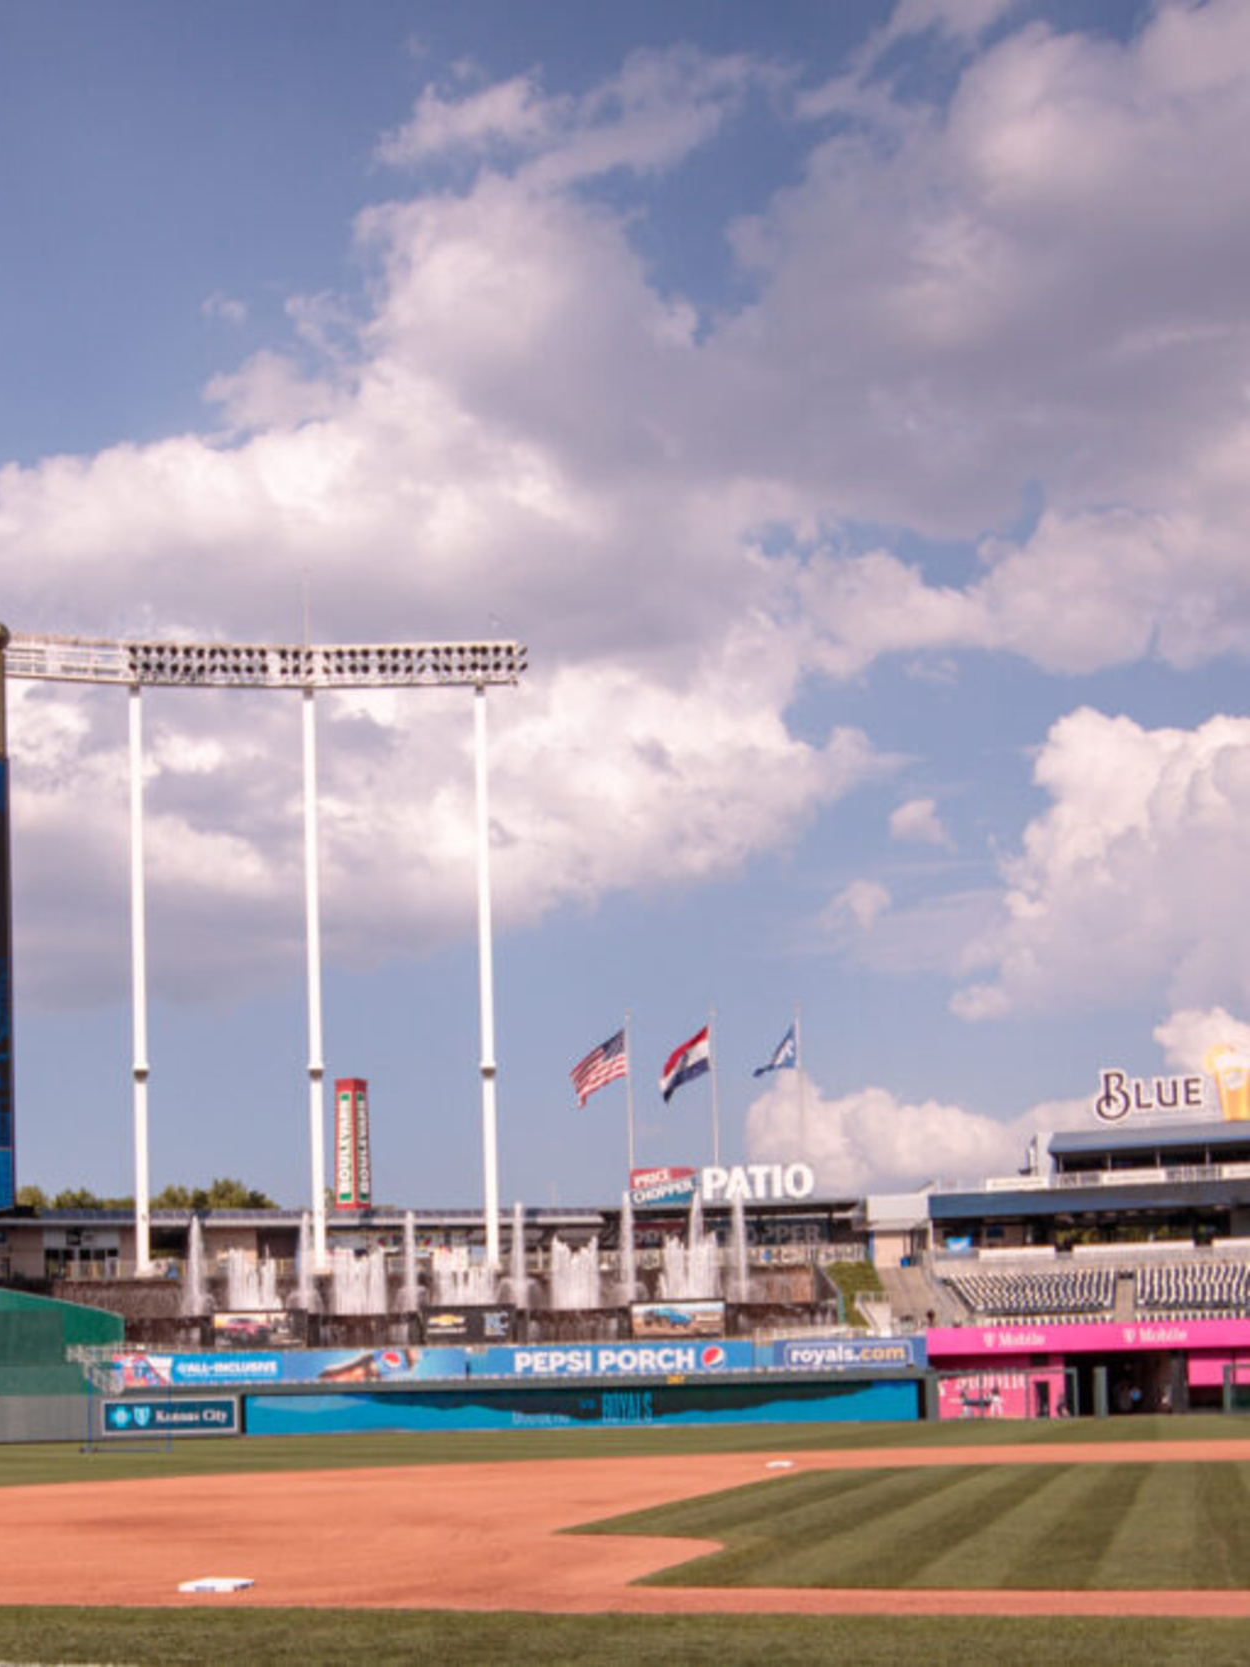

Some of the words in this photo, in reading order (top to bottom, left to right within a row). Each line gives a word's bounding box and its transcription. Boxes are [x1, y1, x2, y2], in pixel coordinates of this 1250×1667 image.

[633, 1167, 670, 1188] PRICE
[702, 1163, 815, 1200] PATIO
[633, 1179, 694, 1205] CHOPPER
[999, 1332, 1046, 1347] Mobile
[514, 1351, 592, 1373] PEPSI
[600, 1347, 695, 1371] PORCH
[790, 1345, 906, 1363] royals.com
[155, 1410, 199, 1422] Kansas
[202, 1409, 228, 1424] City
[602, 1392, 653, 1425] ROYALS
